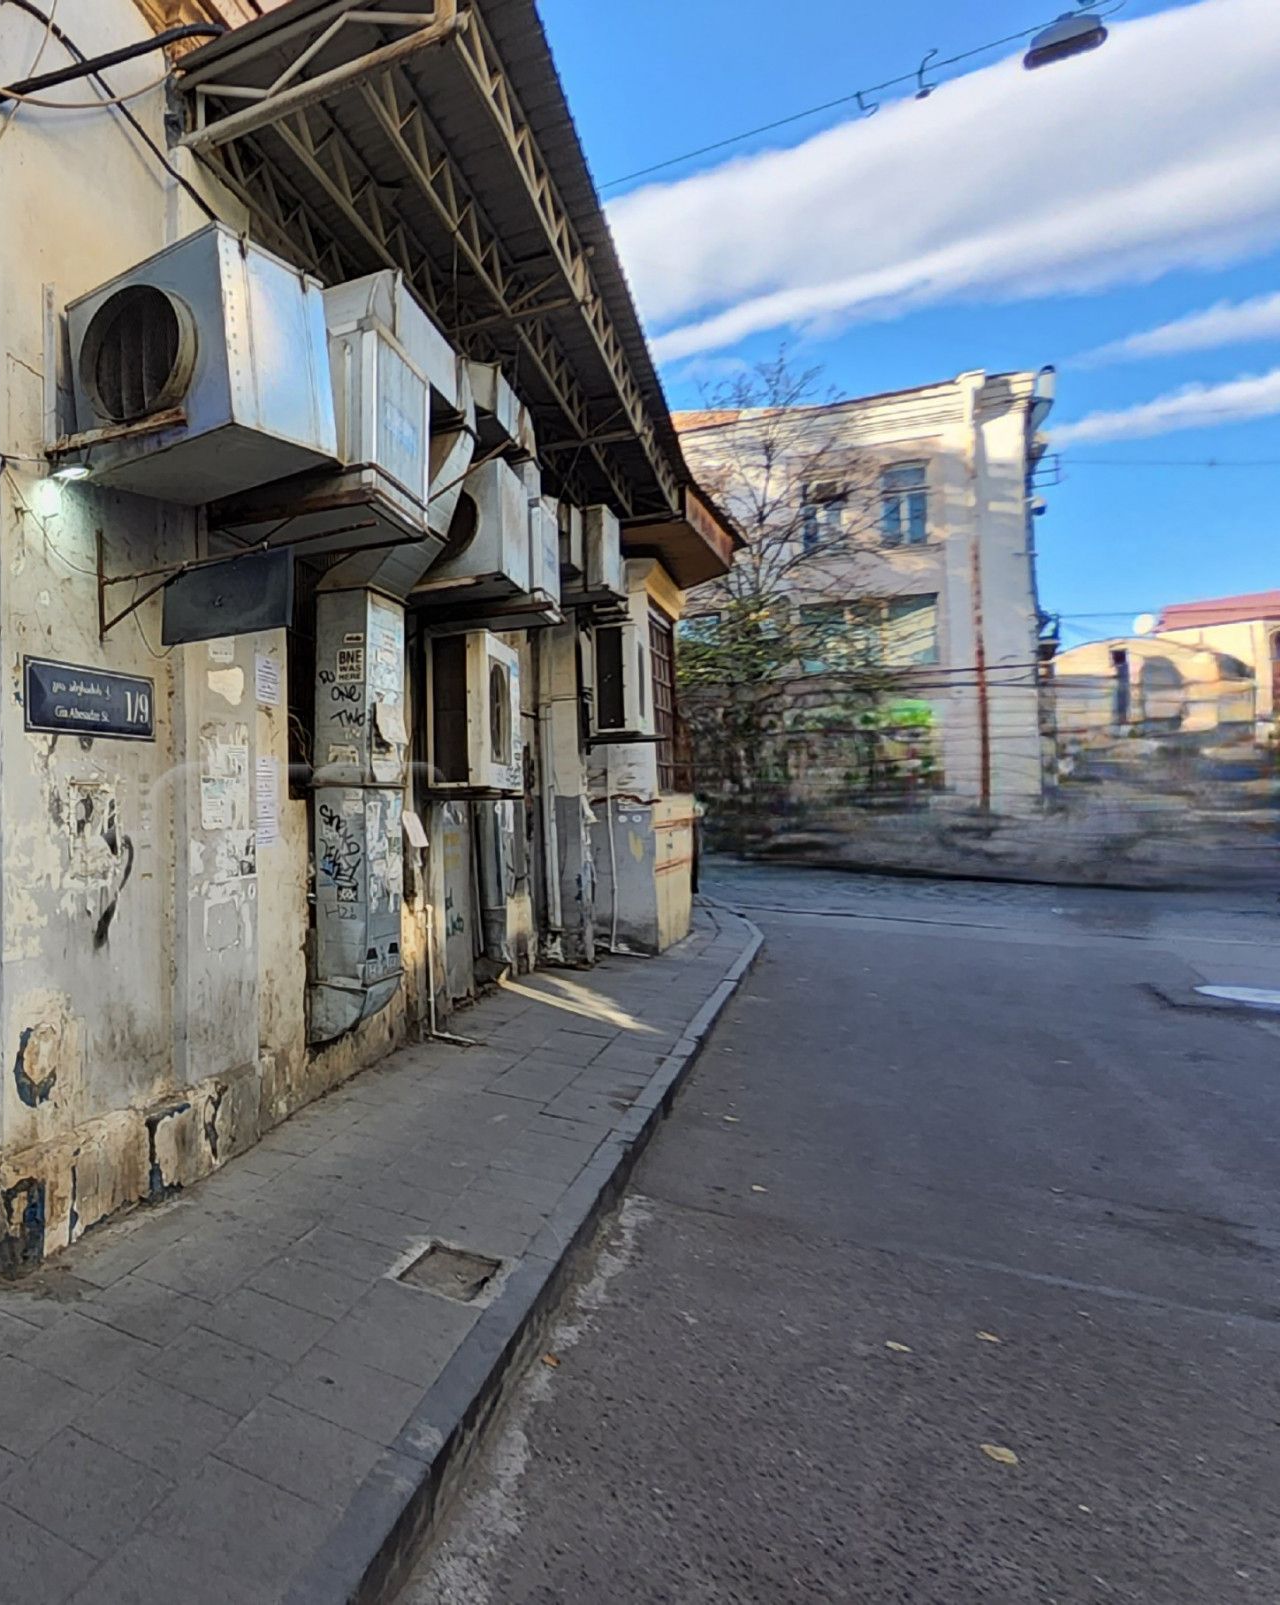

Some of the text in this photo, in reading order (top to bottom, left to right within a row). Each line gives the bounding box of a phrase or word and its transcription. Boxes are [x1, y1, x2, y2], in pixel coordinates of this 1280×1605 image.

[338, 649, 363, 665] BNE
[338, 664, 362, 673] WAS
[124, 690, 150, 724] 1/9
